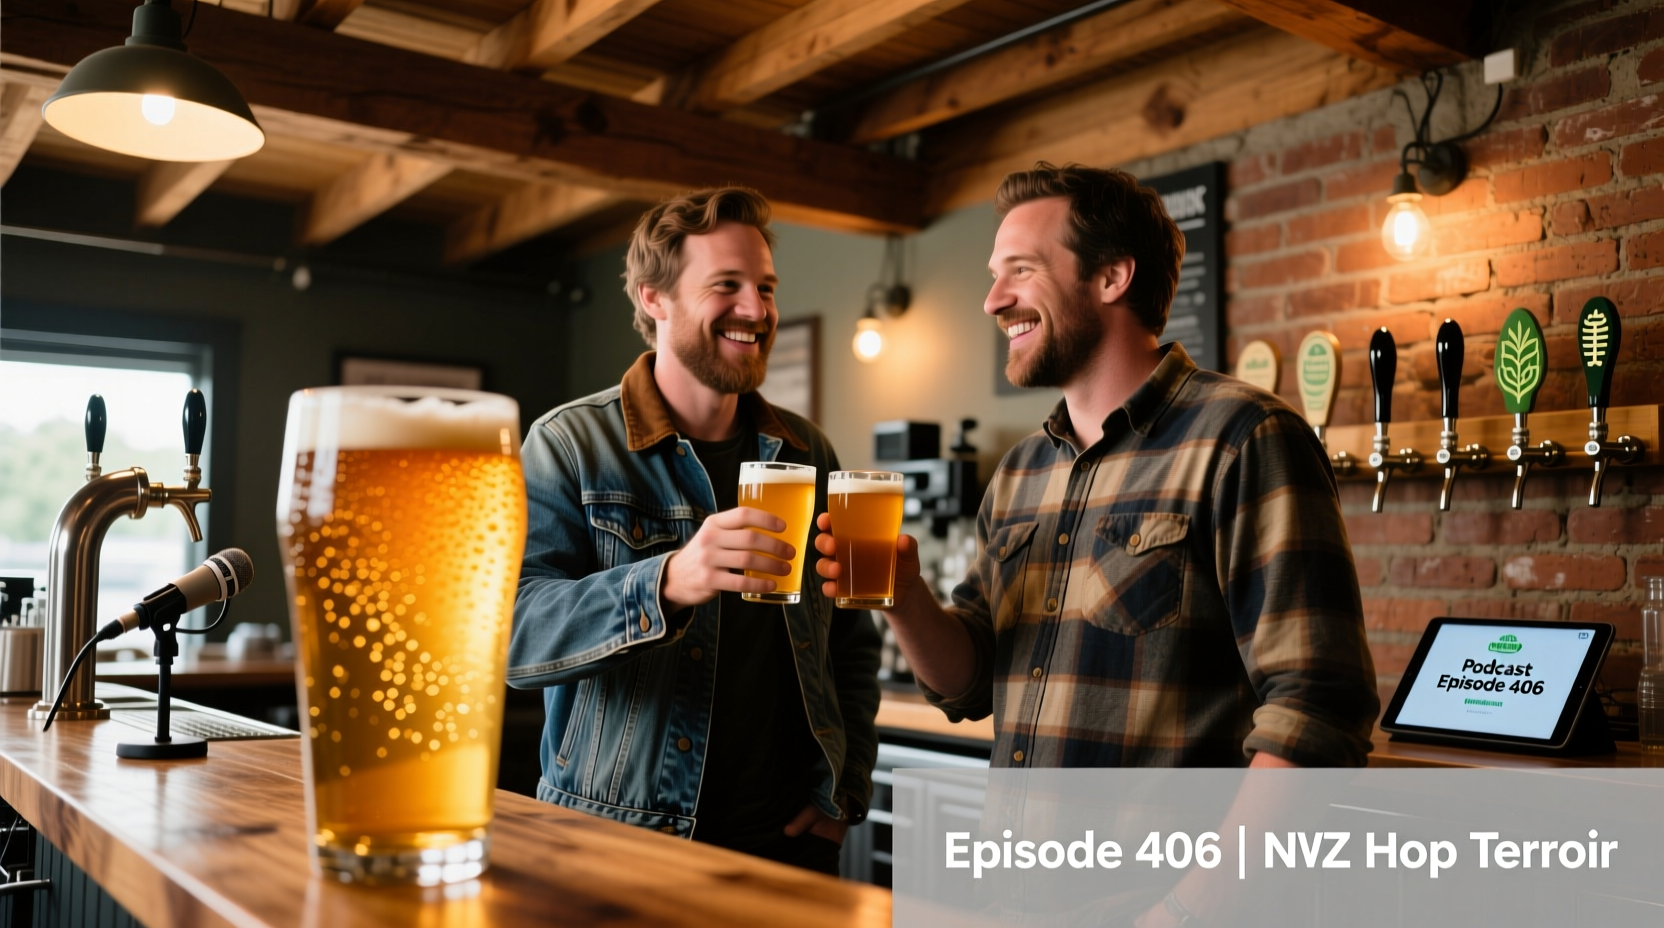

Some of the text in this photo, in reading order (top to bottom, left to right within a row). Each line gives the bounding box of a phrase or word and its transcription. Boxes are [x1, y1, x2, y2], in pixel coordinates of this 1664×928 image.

[1461, 658, 1534, 677] Podcast
[1436, 674, 1545, 696] Episode 406
